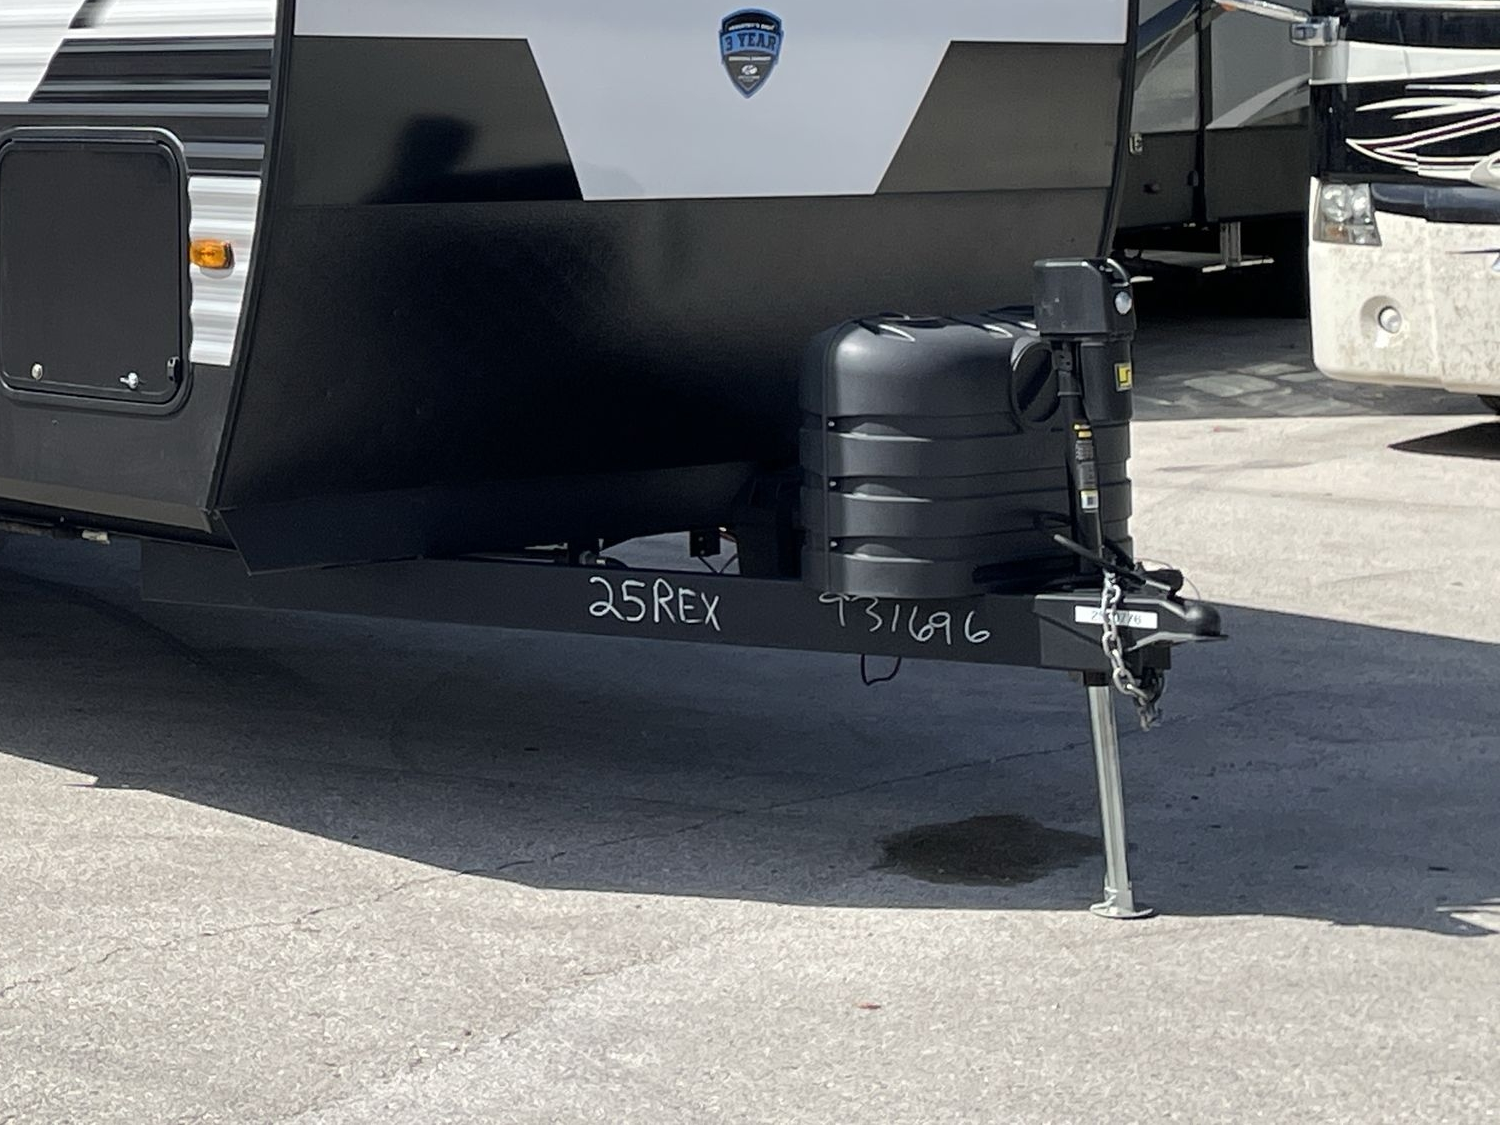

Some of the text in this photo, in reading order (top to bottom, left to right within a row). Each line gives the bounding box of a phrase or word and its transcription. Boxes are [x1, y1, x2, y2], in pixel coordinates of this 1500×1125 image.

[724, 32, 777, 51] 3 YEAR
[588, 576, 722, 632] 25REX
[817, 590, 991, 645] 931696
